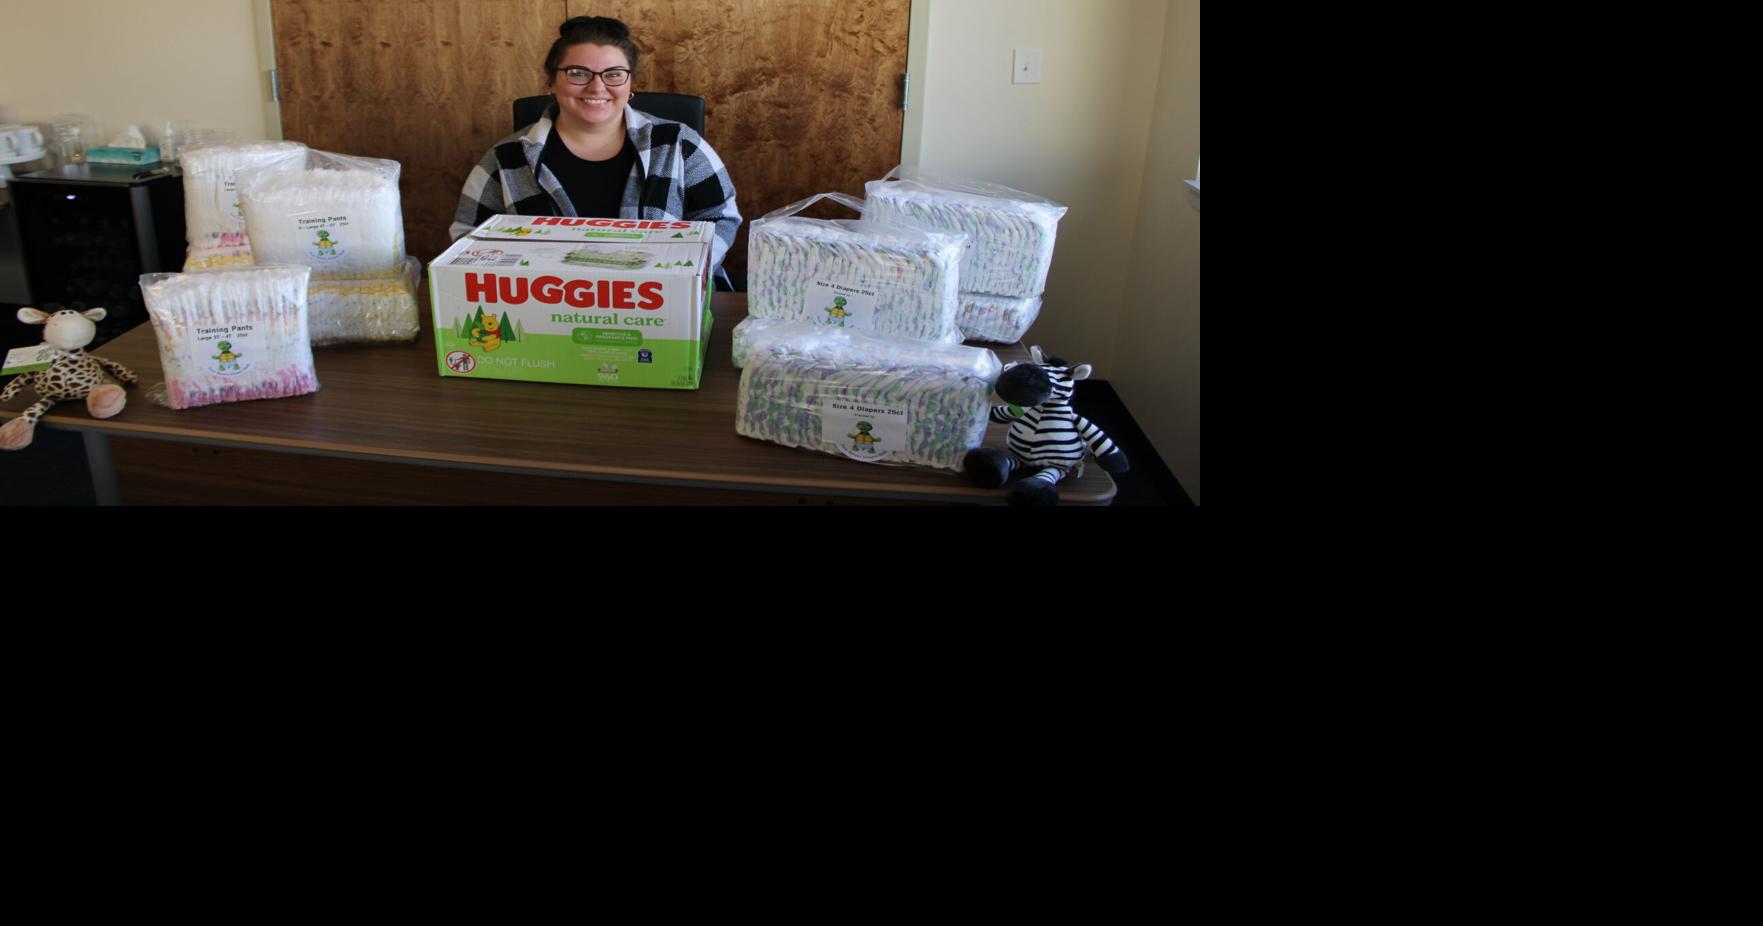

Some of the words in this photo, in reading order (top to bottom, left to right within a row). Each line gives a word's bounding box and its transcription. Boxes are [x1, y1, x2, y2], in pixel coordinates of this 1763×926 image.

[327, 215, 347, 223] Pants
[531, 217, 691, 229] HUGGIES
[465, 272, 664, 310] HUGGIES
[836, 285, 860, 294] Diapers
[551, 312, 618, 325] natural
[623, 315, 664, 327] care
[196, 327, 229, 335] Training
[231, 324, 254, 332] Pants
[478, 355, 493, 365] DO
[495, 357, 519, 367] NOT
[521, 358, 555, 369] FLUSH
[856, 405, 885, 414] Diapers
